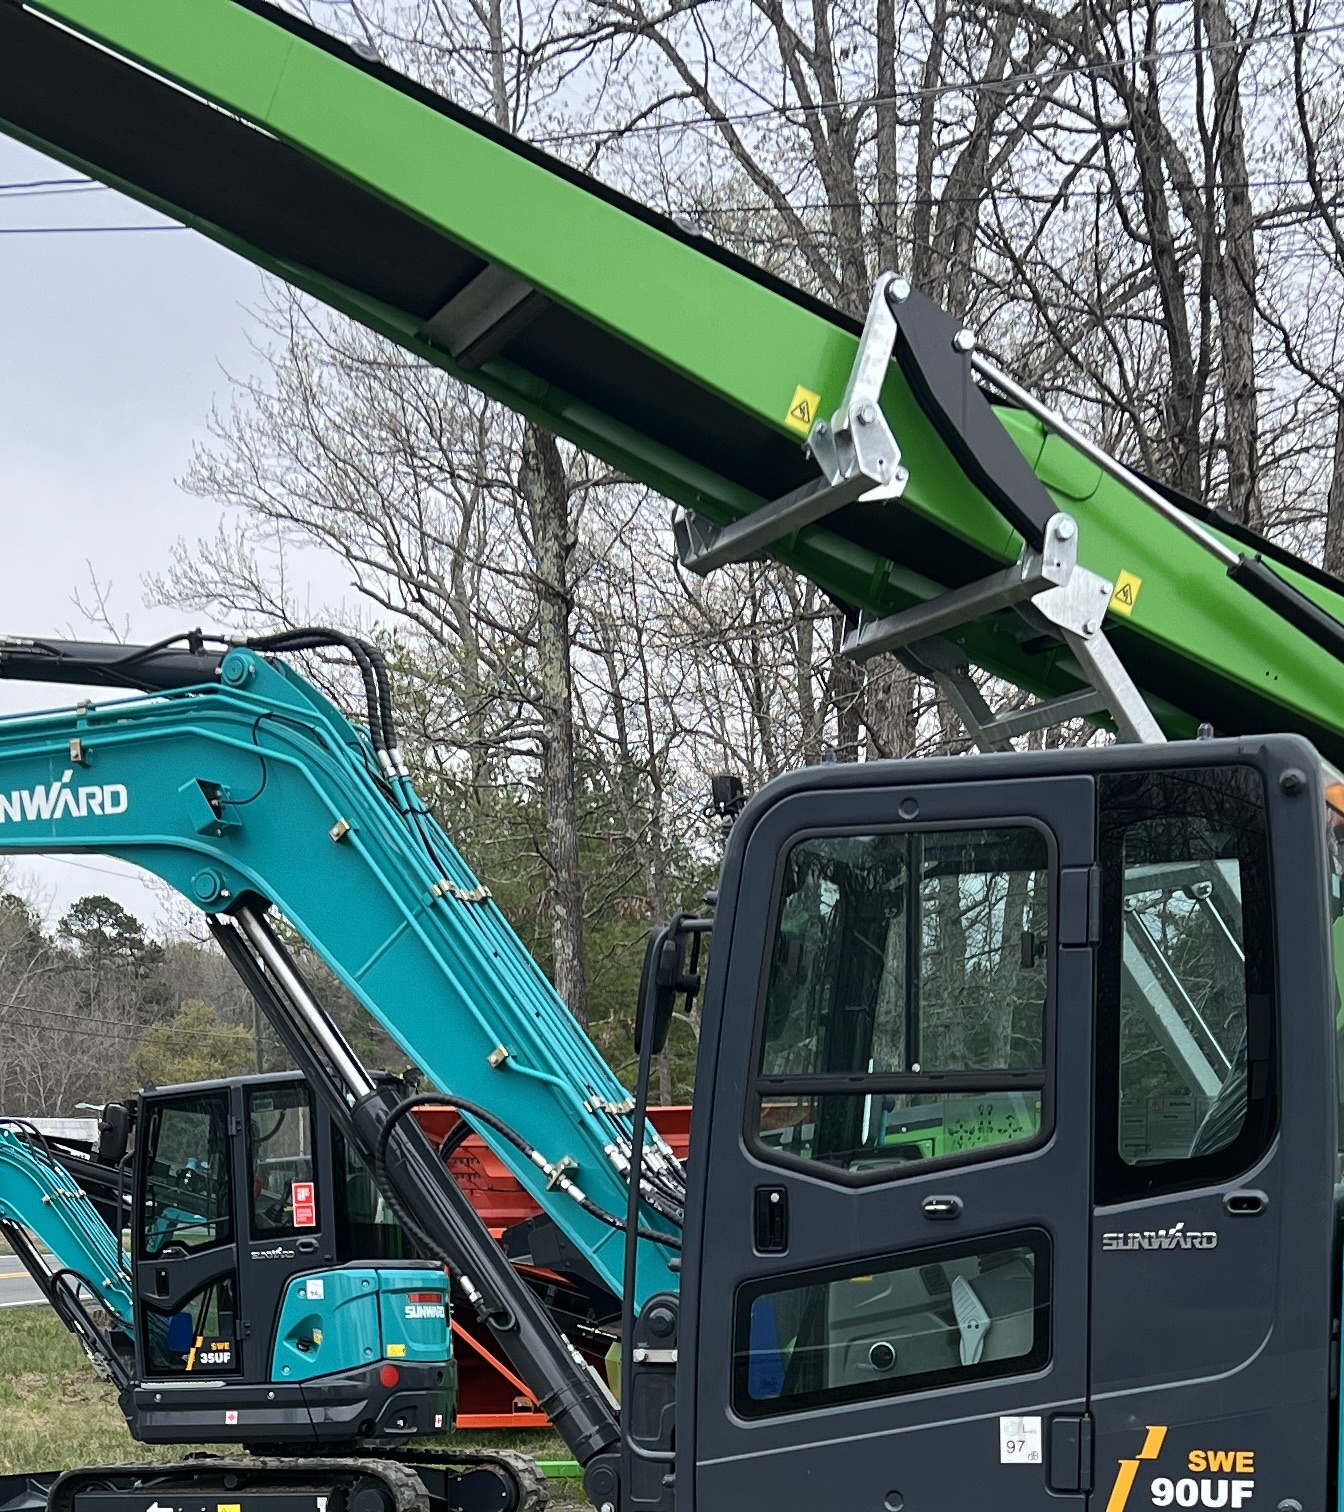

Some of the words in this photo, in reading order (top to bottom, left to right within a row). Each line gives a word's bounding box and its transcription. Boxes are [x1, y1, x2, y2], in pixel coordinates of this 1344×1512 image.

[1102, 1222, 1217, 1251] SUNWARD
[200, 1352, 231, 1364] 35UF
[1006, 1440, 1026, 1454] 97
[1187, 1449, 1255, 1473] SWE
[1150, 1477, 1255, 1509] 90UF
